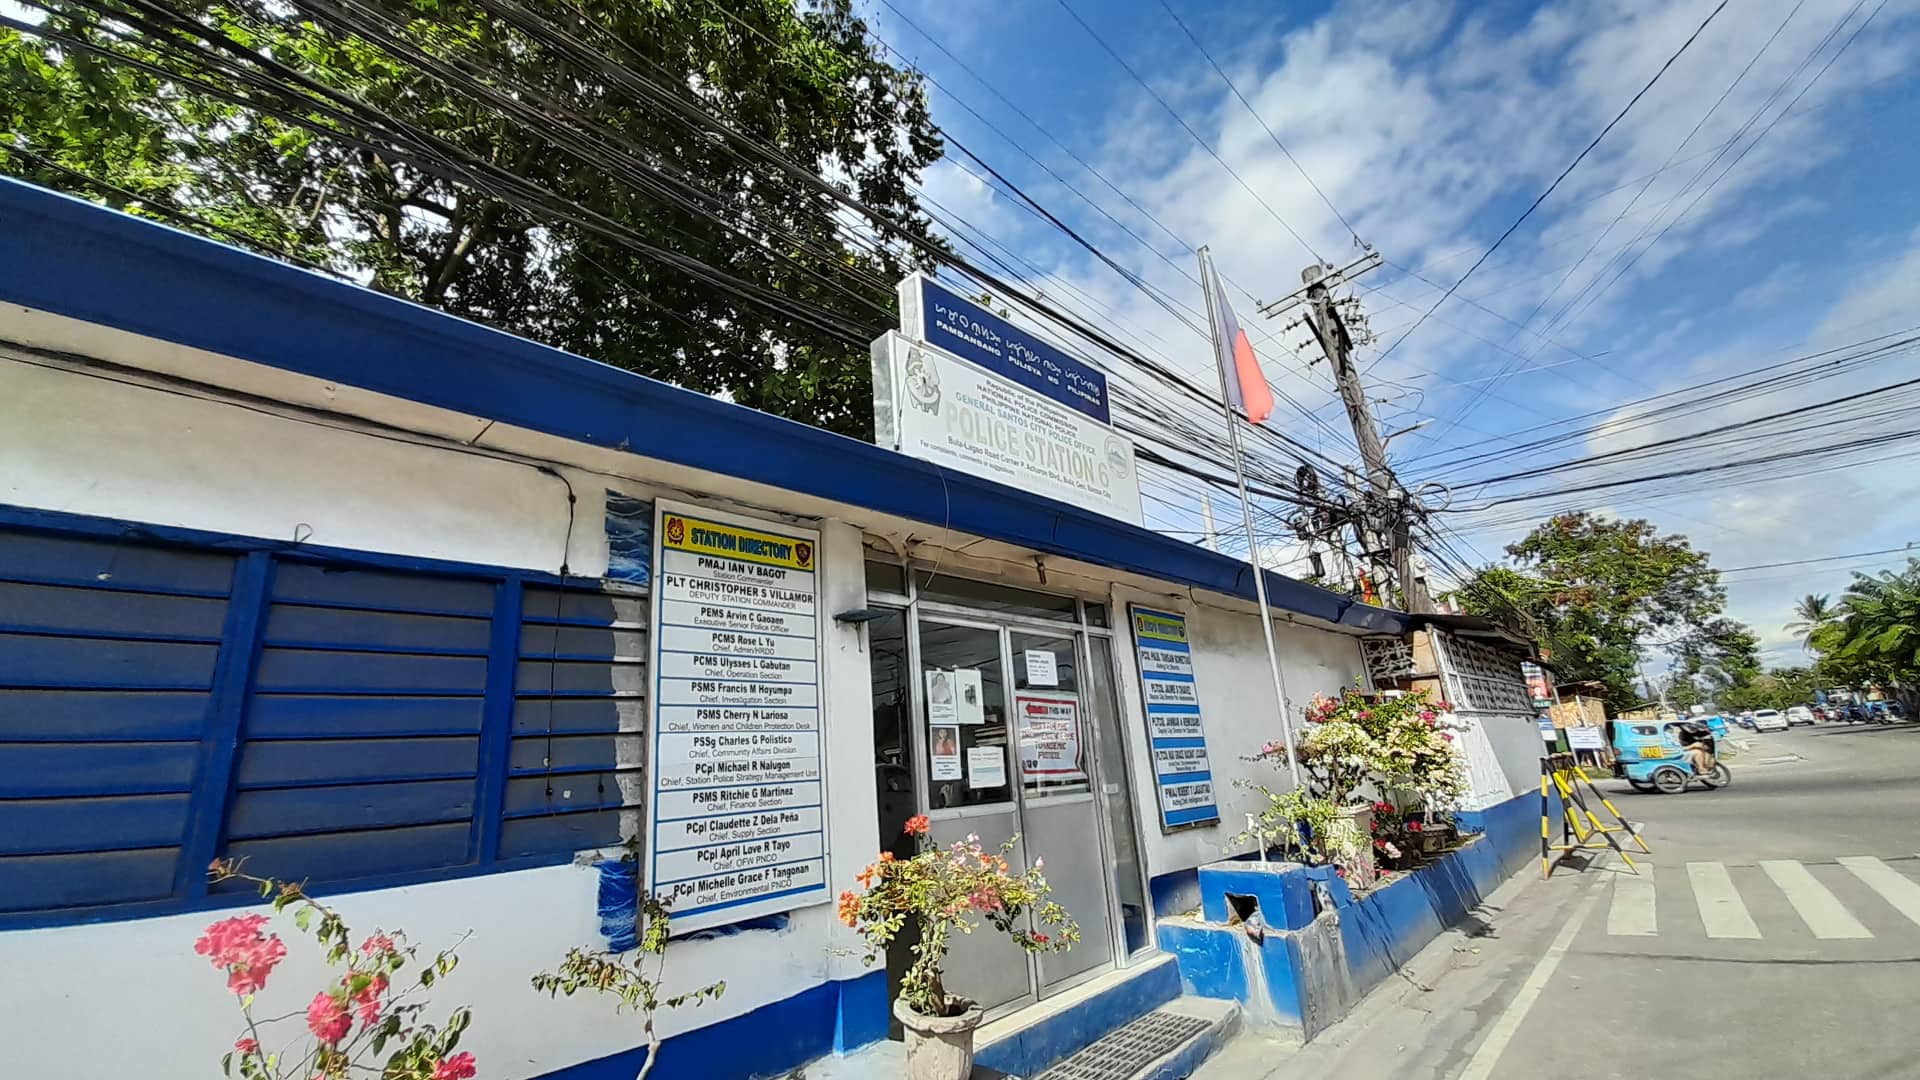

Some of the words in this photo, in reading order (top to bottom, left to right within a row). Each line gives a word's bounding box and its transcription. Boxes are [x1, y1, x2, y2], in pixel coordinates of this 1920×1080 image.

[936, 320, 1002, 357] PAMBANSANG
[1008, 355, 1042, 377] PULISYA
[1048, 375, 1060, 385] NG
[1067, 385, 1101, 406] PILIPINAS
[976, 384, 1012, 404] NATIONAL
[1014, 399, 1038, 415] POLICE
[1040, 410, 1078, 432] COMMISSION
[981, 394, 1020, 415] PHILIPPINE
[1022, 410, 1054, 430] NATIONAL
[956, 392, 995, 415] GENERAL
[997, 409, 1028, 428] SANTOS
[1030, 422, 1047, 436] CITY
[1048, 428, 1073, 447] POLICE
[1074, 440, 1096, 456] OFFICE
[945, 401, 1021, 457] POLICE
[1024, 432, 1094, 484] STATION
[1098, 462, 1110, 488] 6
[691, 528, 736, 551] STATION
[738, 536, 792, 561] DIRECTORY
[698, 558, 726, 571] PMAJ
[728, 562, 744, 574] IAN
[746, 564, 754, 575] V
[756, 566, 786, 580] BAGOT
[666, 575, 686, 588] PLT
[689, 578, 758, 598] CHRISTOPHER
[761, 588, 768, 598] S
[769, 589, 814, 604] VILLAMOR
[690, 590, 720, 602] DEPUTY
[722, 594, 752, 605] STATION
[752, 598, 796, 609] COMMANDER
[700, 607, 724, 618] PEMS
[726, 610, 746, 621] Arvin
[748, 612, 754, 621] C
[712, 633, 736, 644] PCMS
[738, 635, 758, 647] Rose
[758, 637, 764, 646] L
[764, 638, 775, 648] Yu
[693, 656, 718, 667] PCMS
[720, 658, 752, 670] Ulysses
[753, 660, 758, 669] L
[760, 660, 790, 672] Gabutan
[691, 682, 716, 693] PSMS
[718, 683, 748, 694] Francis
[749, 684, 756, 694] M
[758, 684, 792, 696] Hoyumpa
[696, 709, 721, 720] PSMS
[723, 710, 750, 722] Cherry
[752, 710, 759, 720] N
[761, 710, 788, 720] Lariosa
[692, 722, 720, 730] Women
[720, 722, 735, 730] and
[693, 736, 716, 748] PSSg
[718, 736, 750, 746] Charles
[752, 735, 758, 745] G
[760, 735, 793, 745] Polistico
[696, 763, 716, 776] PCpl
[717, 762, 750, 774] Michael
[752, 761, 758, 771] R
[760, 760, 790, 772] Nalugon
[686, 776, 711, 786] Station
[692, 792, 718, 804] PSMS
[720, 790, 750, 802] Ritchie
[752, 788, 758, 798] G
[760, 787, 794, 798] Martinez
[730, 800, 758, 810] Finance
[686, 822, 708, 836] PCpl
[710, 817, 750, 832] Claudette
[752, 816, 758, 826] Z
[760, 814, 778, 825] Dela
[732, 828, 756, 840] Supply
[697, 850, 718, 864] PCpl
[720, 846, 740, 860] April
[742, 844, 762, 856] Love
[764, 842, 770, 852] R
[772, 840, 790, 853] Tayo
[736, 858, 754, 868] OFW
[756, 854, 778, 864] PNCO
[674, 884, 696, 898] PCpl
[698, 876, 736, 892] Michelle
[738, 872, 763, 885] Grace
[764, 870, 770, 880] F
[772, 864, 810, 879] Tangonan
[720, 883, 770, 901] Environmental
[770, 879, 792, 890] PNCO
